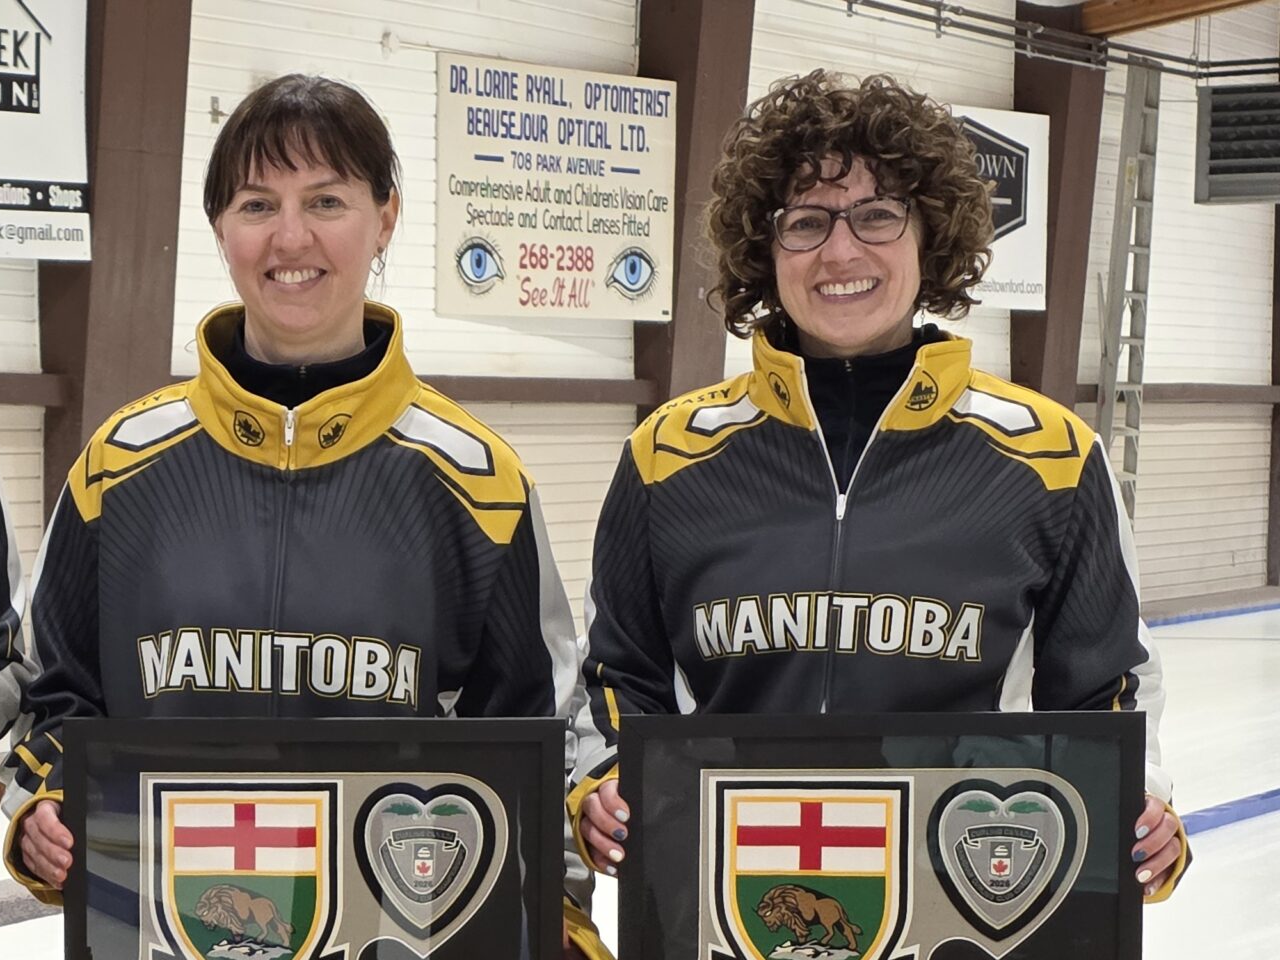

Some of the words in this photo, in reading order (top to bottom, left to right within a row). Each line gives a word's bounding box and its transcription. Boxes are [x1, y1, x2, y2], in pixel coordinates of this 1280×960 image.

[450, 64, 472, 95] DR.
[475, 67, 518, 101] LORNE
[526, 74, 572, 109] RYALL,
[584, 82, 671, 118] OPTOMETRIST
[467, 106, 549, 143] BEAUSEJOUR
[558, 117, 612, 150] OPTICAL
[620, 123, 650, 153] LTD.
[511, 150, 532, 171] 708
[536, 153, 562, 173] PARK
[566, 157, 605, 177] AVENUE
[976, 152, 1017, 178] OWN
[48, 185, 83, 209] Shops
[448, 173, 523, 201] Comprehensive
[525, 178, 552, 204] Adult
[554, 184, 572, 205] and
[574, 182, 619, 209] Children's
[619, 185, 645, 211] Vision
[647, 189, 669, 213] Care
[466, 202, 515, 227] Spectacle
[518, 208, 537, 229] and
[543, 208, 583, 232] Contact
[586, 210, 620, 235] Lenses
[621, 213, 650, 237] Fitted
[519, 243, 594, 272] 268-2388
[549, 276, 566, 307] It
[693, 591, 985, 662] MANITOBA
[137, 627, 421, 710] MANITOBA
